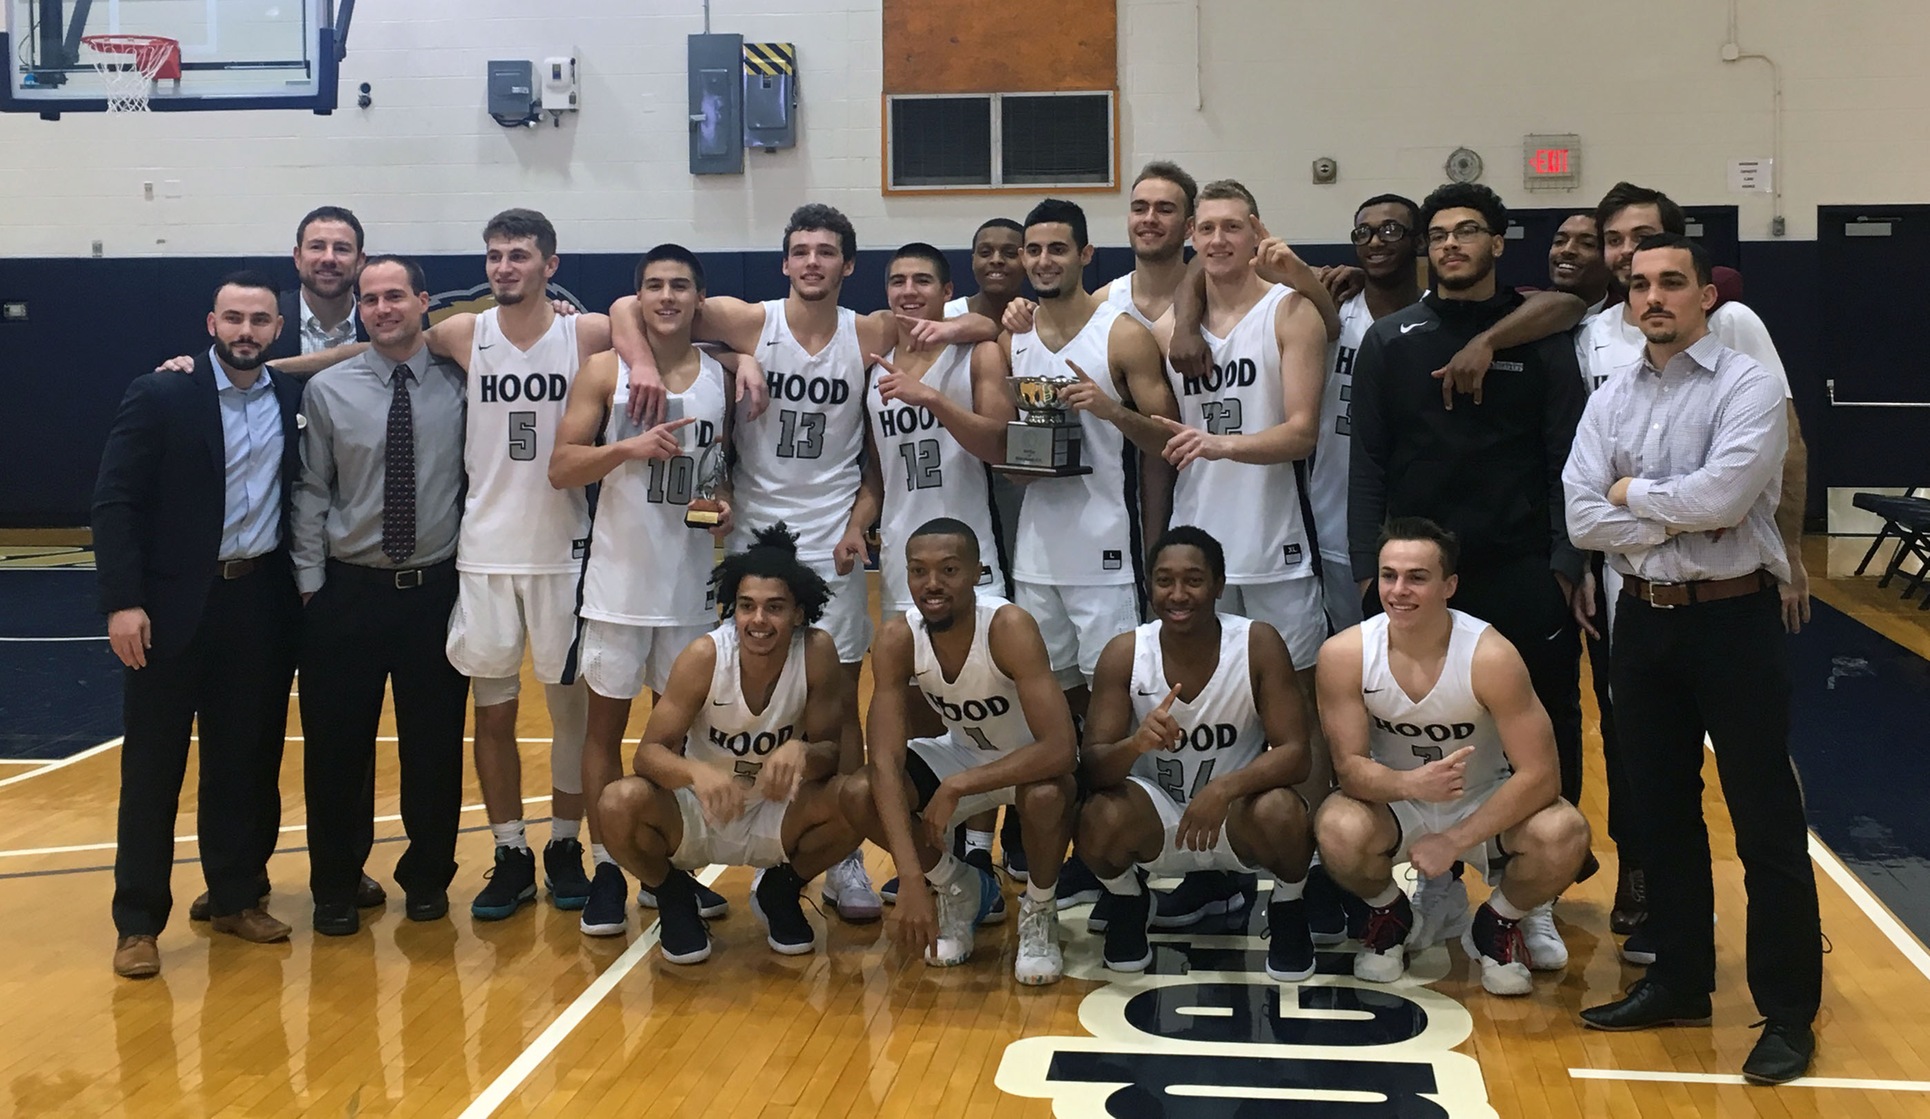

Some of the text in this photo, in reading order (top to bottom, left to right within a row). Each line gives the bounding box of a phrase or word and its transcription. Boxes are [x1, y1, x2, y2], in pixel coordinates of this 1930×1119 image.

[1536, 149, 1568, 173] EXIT
[480, 373, 567, 402] HOOD
[767, 371, 849, 405] HOOD
[508, 411, 537, 461] 5
[776, 409, 827, 459] 13
[878, 405, 945, 438] HOO
[647, 456, 694, 505] 10
[899, 438, 942, 492] 12
[1172, 723, 1237, 753] OOD
[1372, 715, 1475, 741] HOOD
